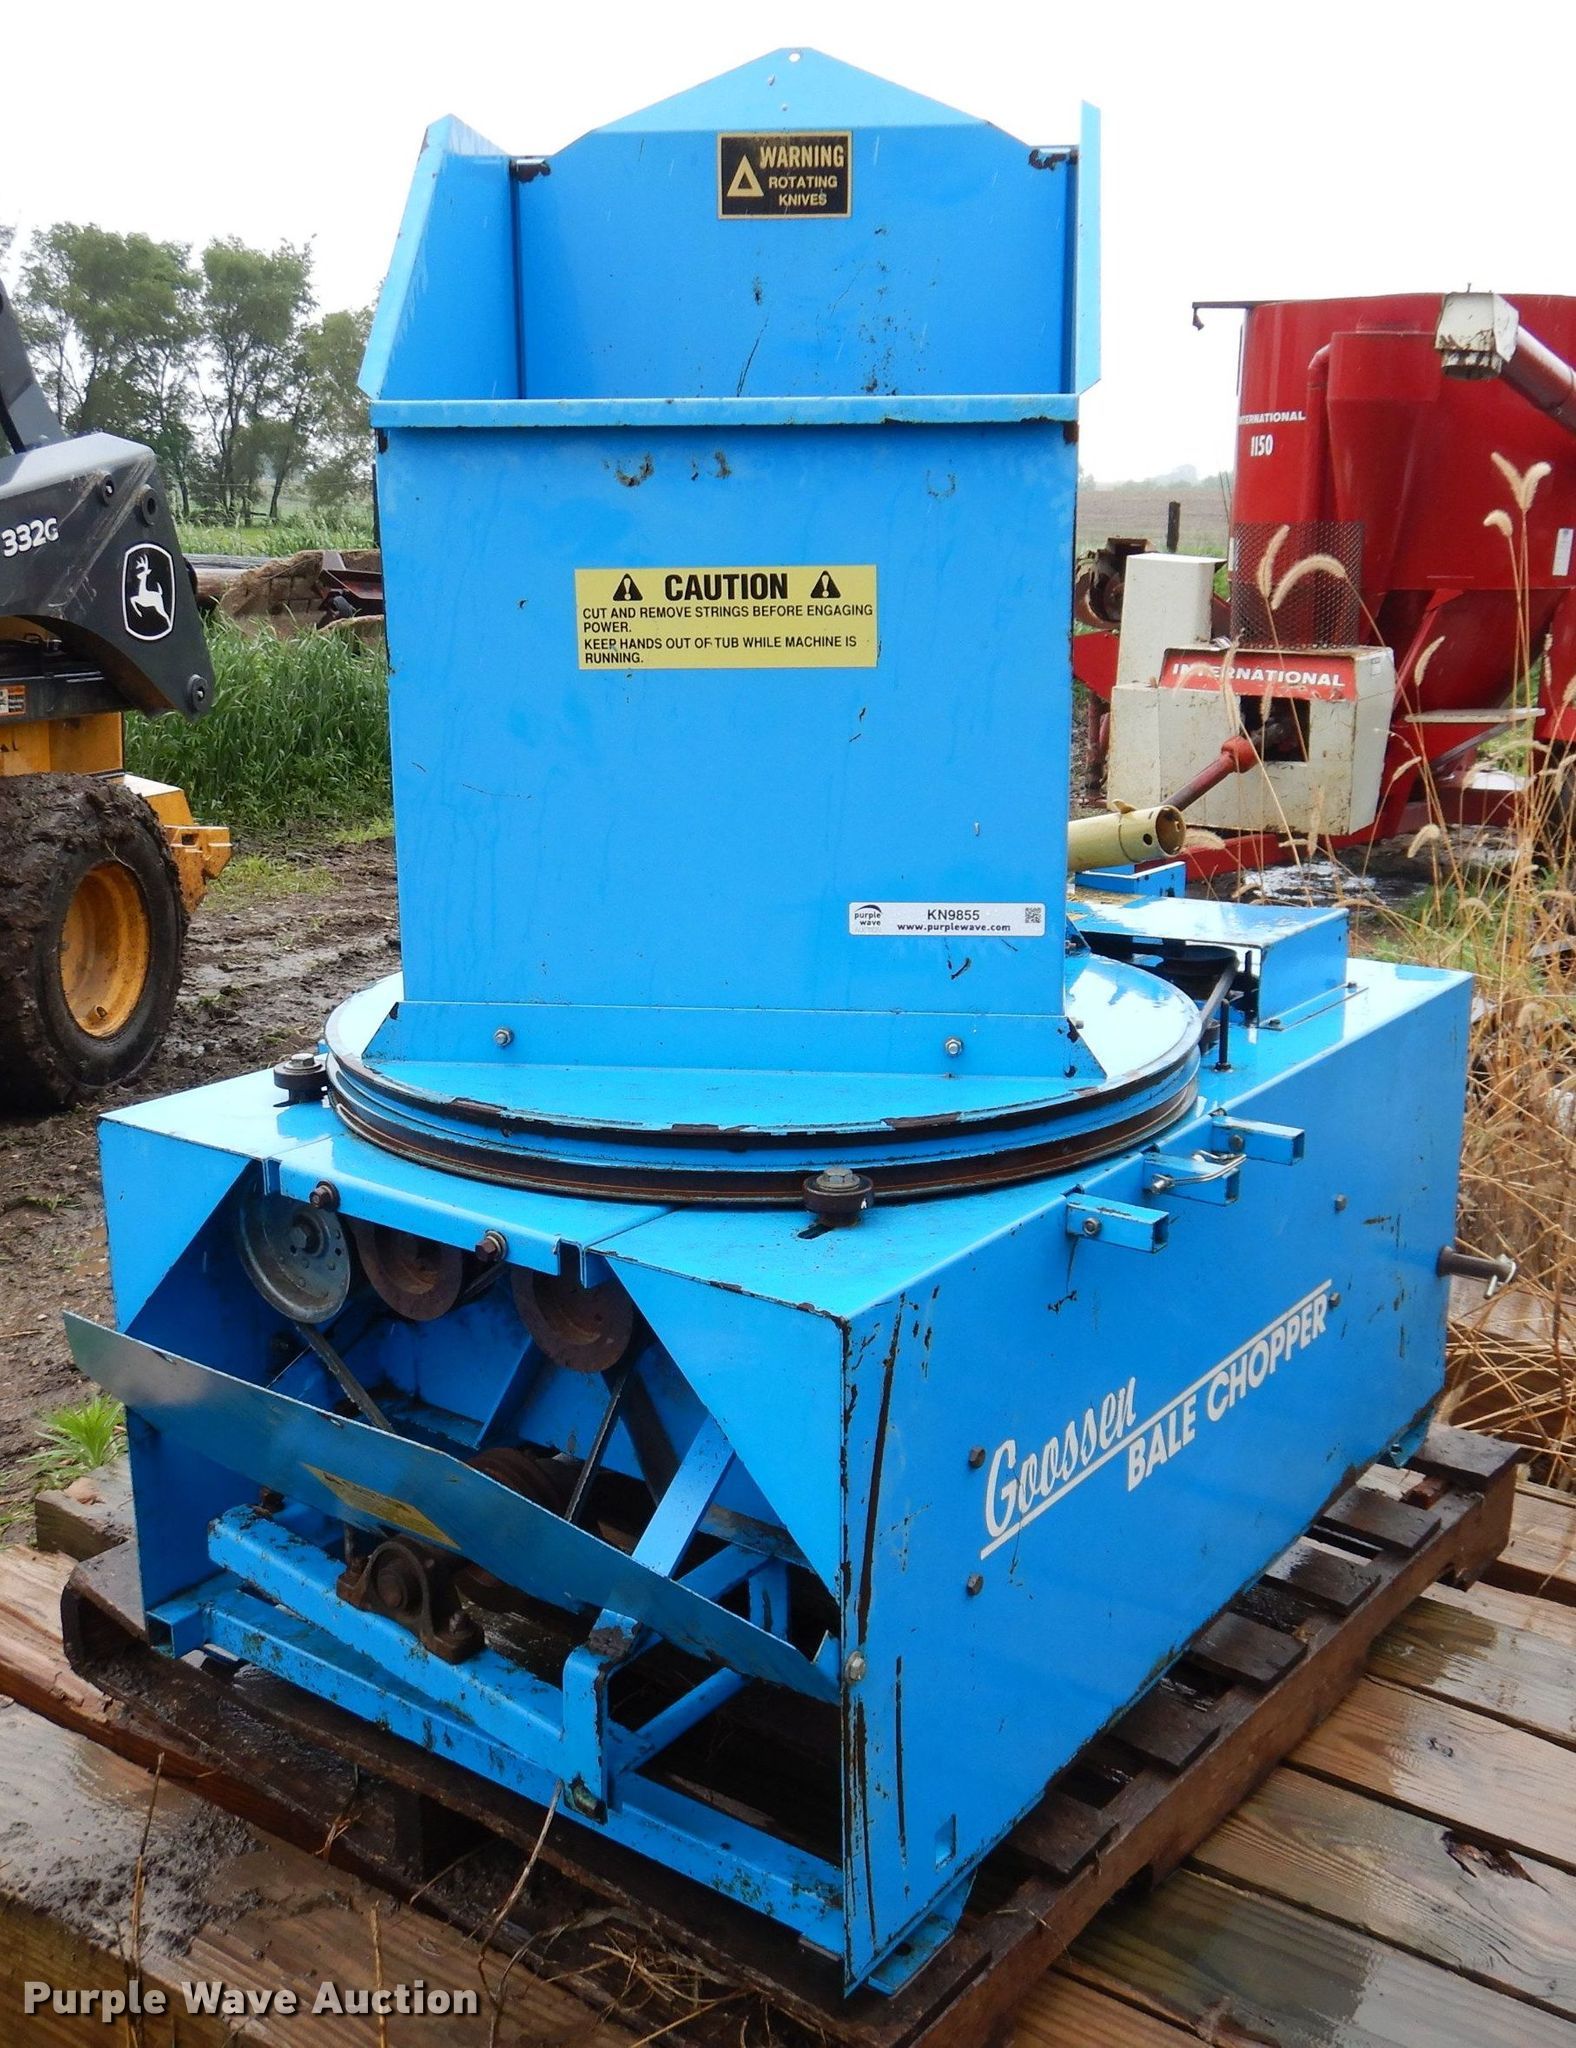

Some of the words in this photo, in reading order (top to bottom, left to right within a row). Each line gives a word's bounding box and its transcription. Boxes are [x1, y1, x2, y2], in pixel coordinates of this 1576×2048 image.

[759, 145, 845, 169] WARNING
[768, 175, 838, 189] ROTATING
[778, 193, 828, 206] KNIVES
[1250, 434, 1274, 457] 1150
[1, 517, 60, 557] 332G
[664, 572, 788, 601] CAUTION
[582, 607, 608, 619] CUT
[610, 607, 636, 619] AND
[640, 606, 692, 618] REMOVE
[695, 606, 749, 618] STRINGS
[752, 605, 803, 617] BEFORE
[807, 604, 873, 616] ENGAGING
[583, 621, 632, 633] POWER.
[584, 638, 617, 650] KEEP
[619, 638, 663, 650] HANDS
[665, 638, 691, 649] OUT
[694, 637, 711, 649] OF
[714, 637, 739, 649] TUB
[743, 636, 782, 648] WHILE
[785, 636, 842, 647] MACHINE
[845, 635, 857, 647] IS
[585, 652, 644, 664] RUNNING.
[854, 911, 881, 920] purple
[927, 909, 980, 920] KN9855
[897, 922, 1011, 932] www.purplewave.com
[1128, 1394, 1197, 1492] BALE
[1206, 1293, 1329, 1422] CHOPPER
[984, 1377, 1137, 1538] Goossen
